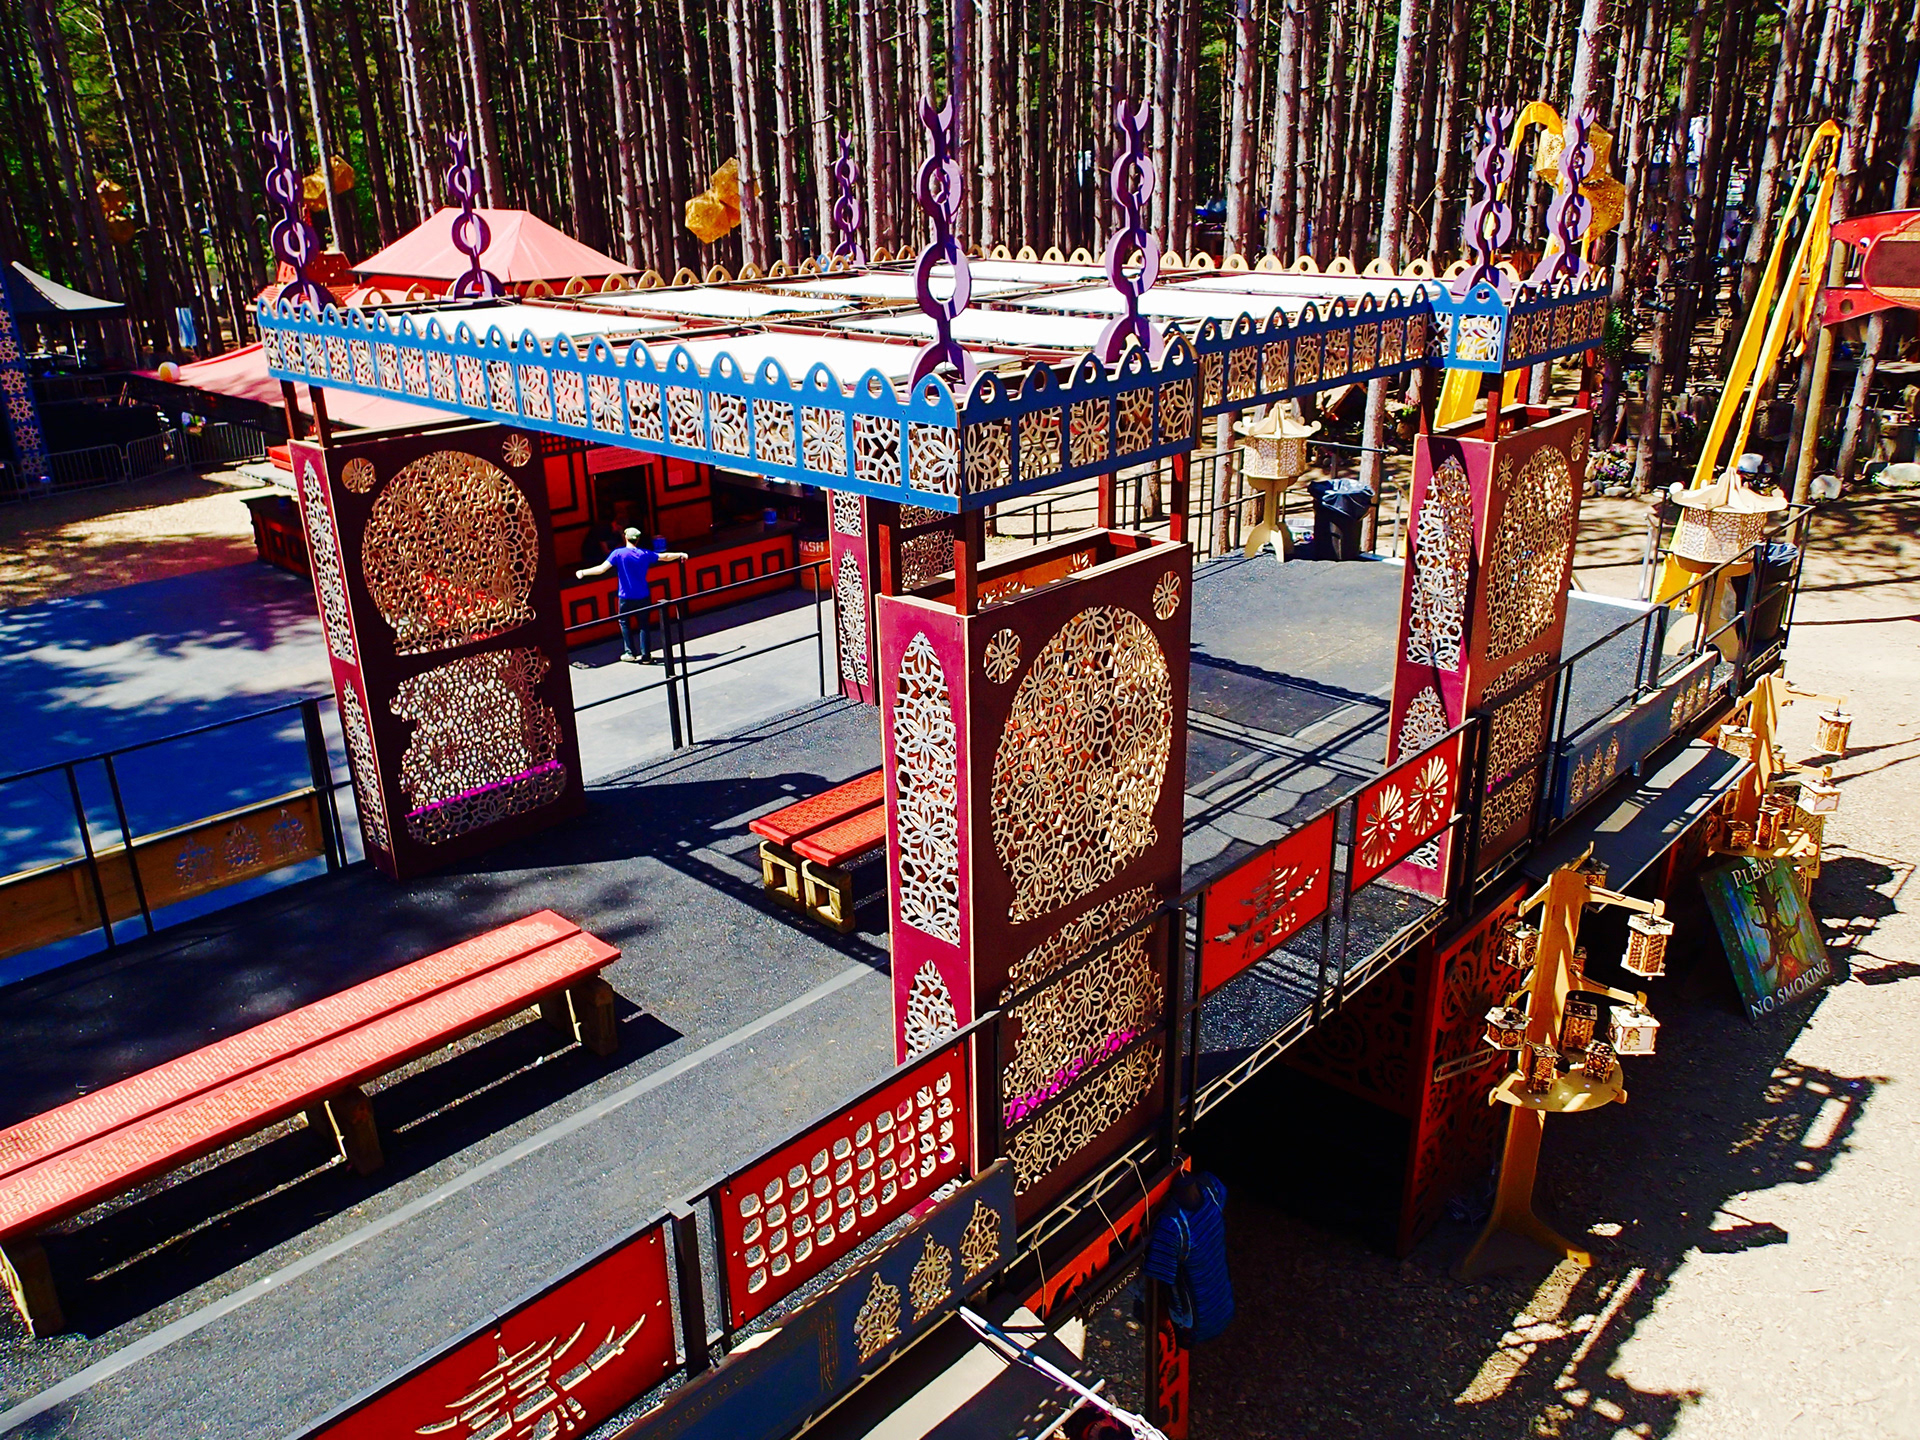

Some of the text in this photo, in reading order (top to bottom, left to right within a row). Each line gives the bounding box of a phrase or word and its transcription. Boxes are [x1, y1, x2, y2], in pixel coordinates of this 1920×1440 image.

[799, 540, 824, 552] RASH
[1731, 857, 1777, 889] PLEASE
[1750, 958, 1831, 1018] NO SMOKING
